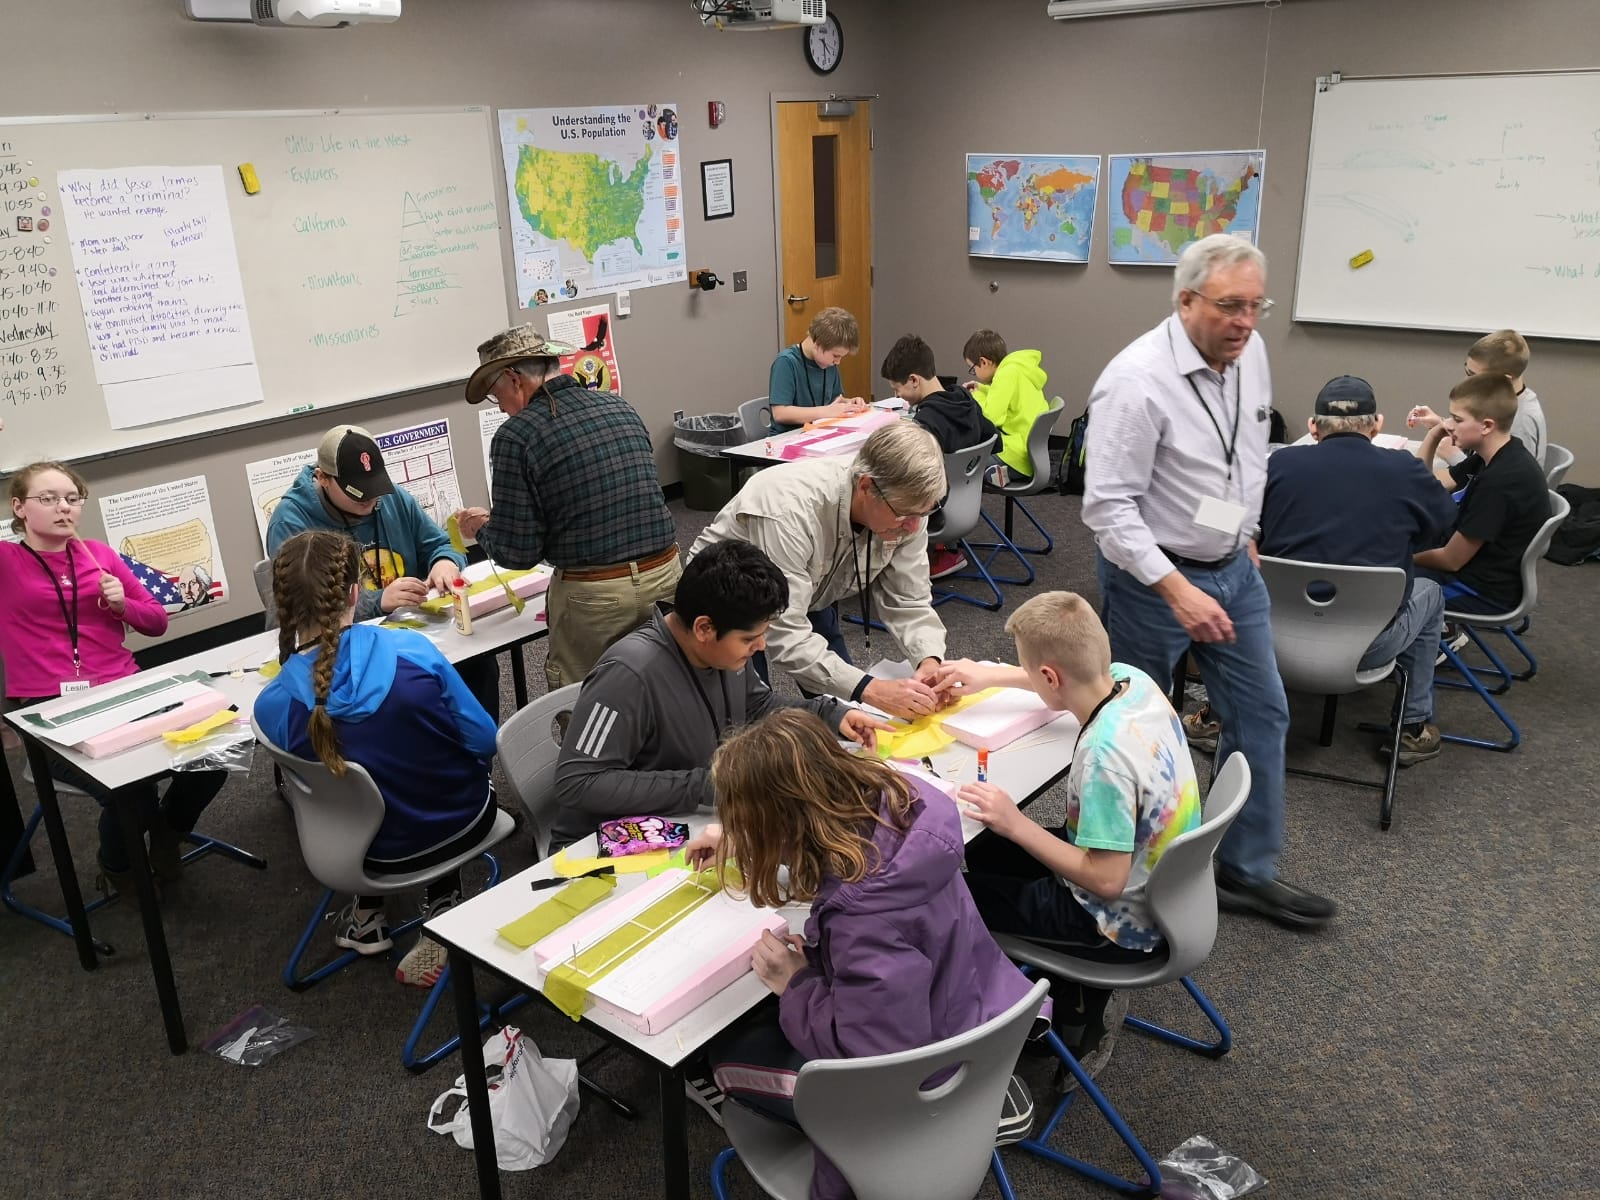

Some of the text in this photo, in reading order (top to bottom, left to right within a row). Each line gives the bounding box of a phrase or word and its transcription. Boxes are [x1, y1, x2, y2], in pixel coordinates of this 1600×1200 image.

[552, 113, 631, 127] Understanding the
[560, 126, 626, 140] U.S. Population
[69, 181, 91, 197] Why
[101, 178, 117, 192] did
[294, 211, 348, 233] California
[378, 424, 445, 448] U.S. GOVERNMENT
[65, 684, 89, 692] Leslie
